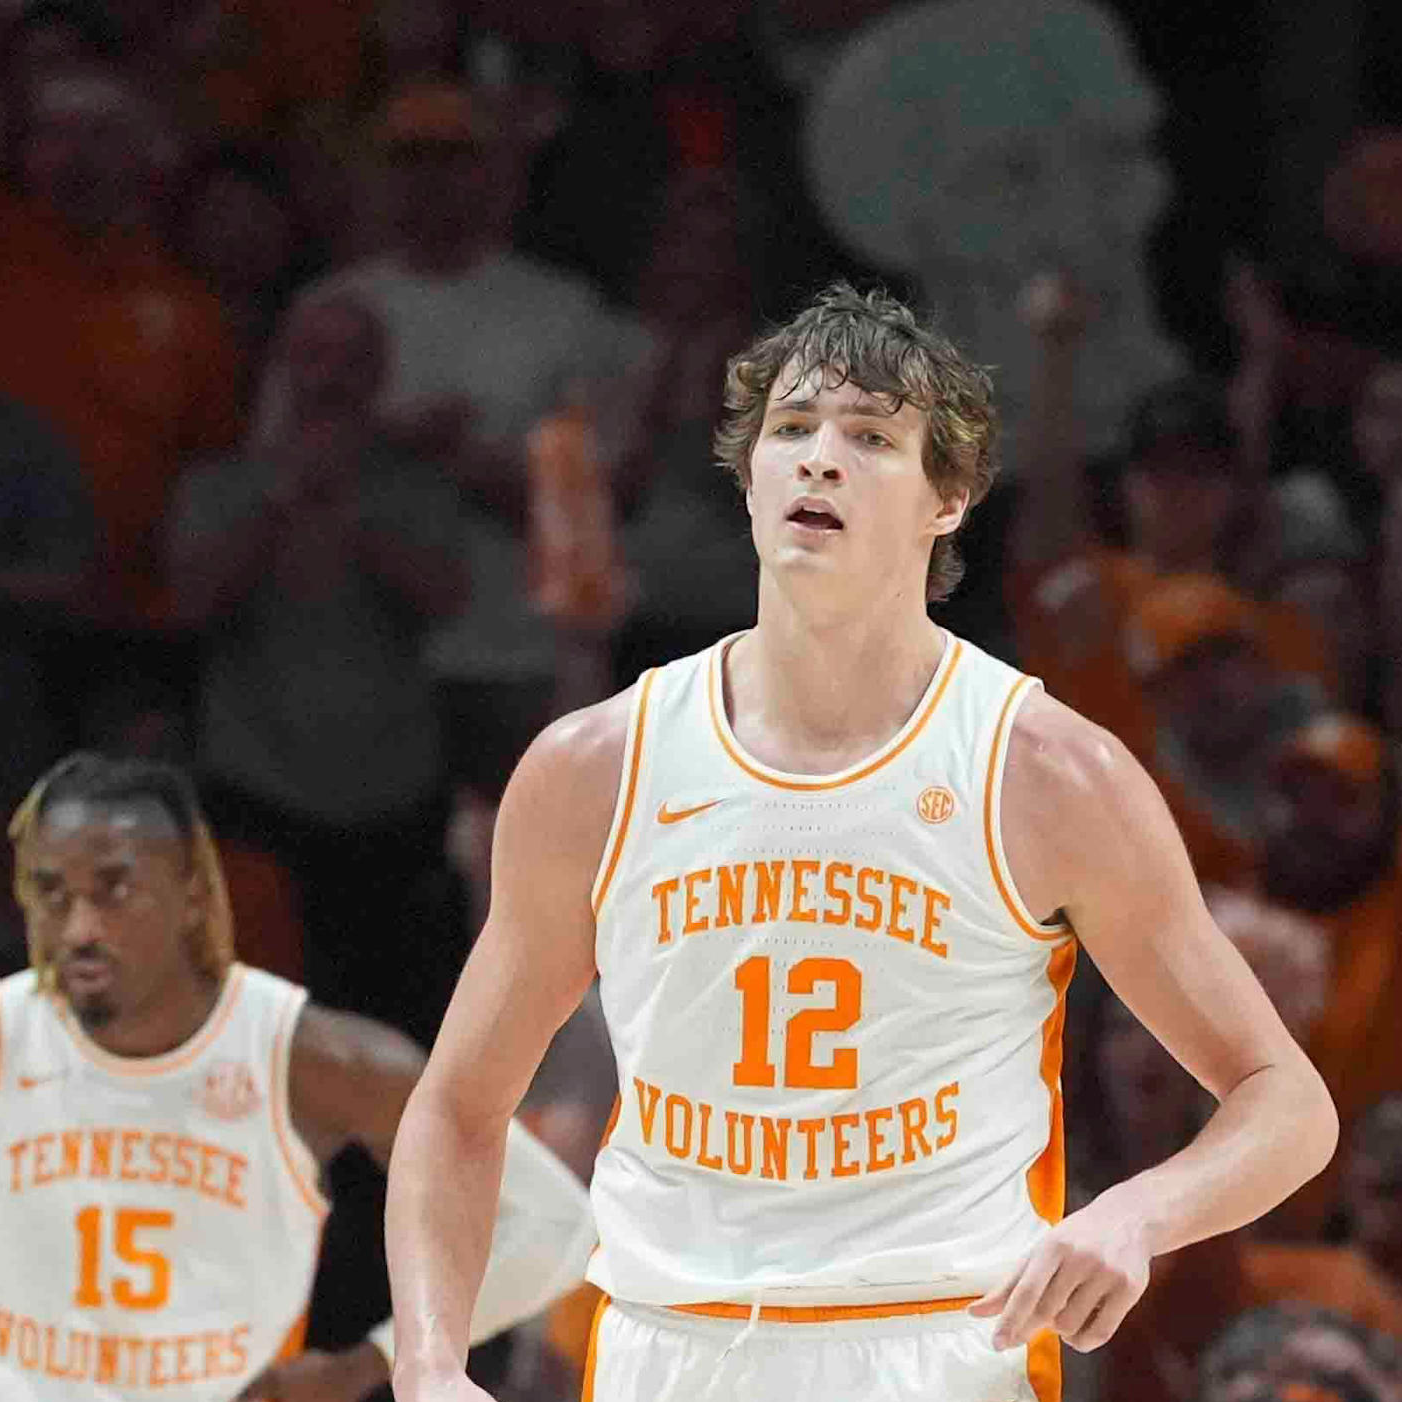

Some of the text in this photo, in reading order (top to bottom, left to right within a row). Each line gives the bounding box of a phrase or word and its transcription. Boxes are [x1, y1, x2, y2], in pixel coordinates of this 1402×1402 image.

[920, 789, 952, 820] SEC
[652, 859, 951, 958] TENNESSEE
[732, 955, 863, 1090] 12
[9, 1129, 248, 1209] TENNESSEE
[634, 1081, 960, 1181] VOLUNTEERS
[73, 1205, 175, 1313] 15
